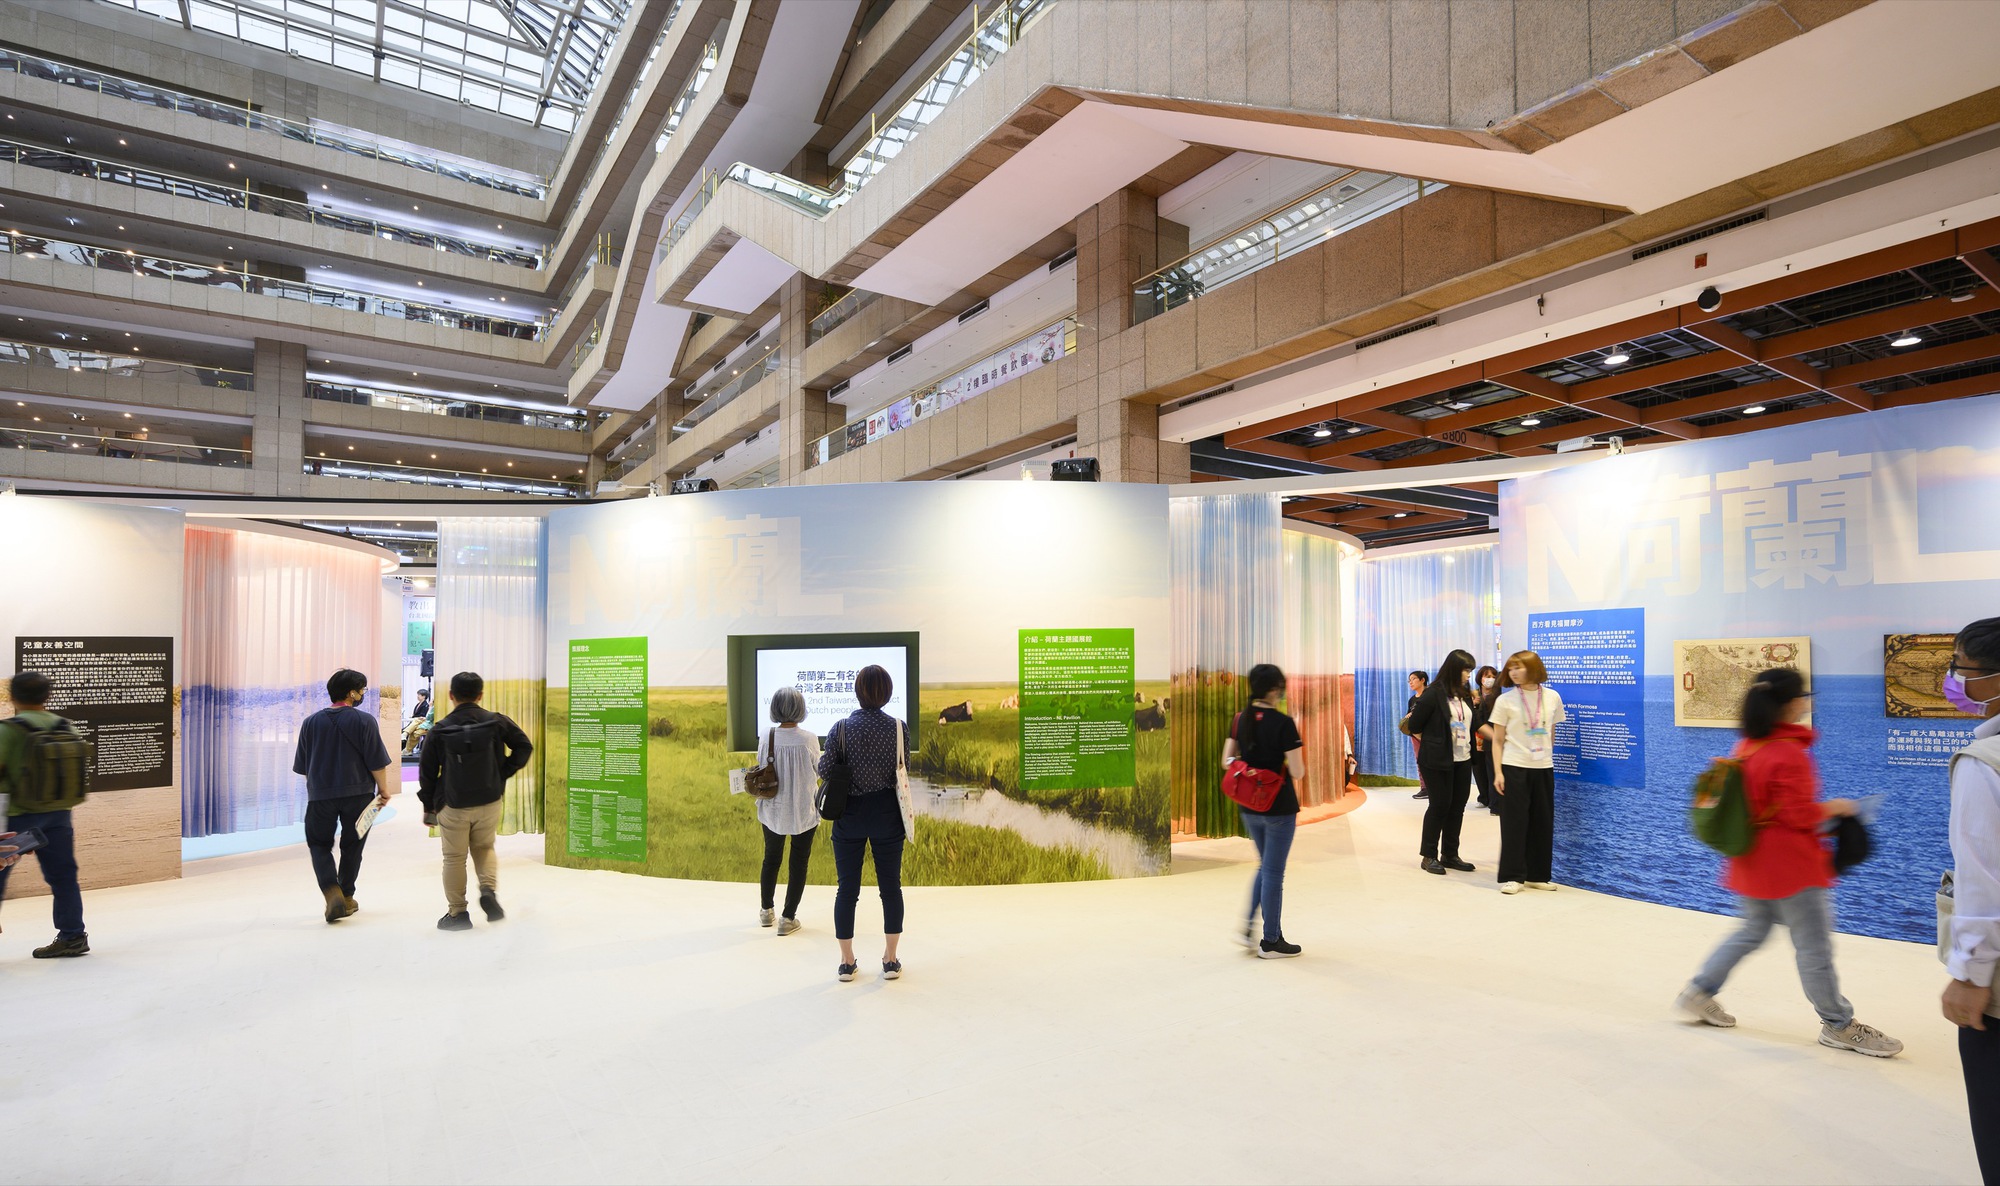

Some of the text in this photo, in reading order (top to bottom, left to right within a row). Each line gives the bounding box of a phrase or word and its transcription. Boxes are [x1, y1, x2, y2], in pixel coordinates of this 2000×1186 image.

[795, 682, 855, 693] 台灣名產是甚
[1888, 744, 1964, 752] 而我相信這個島就
